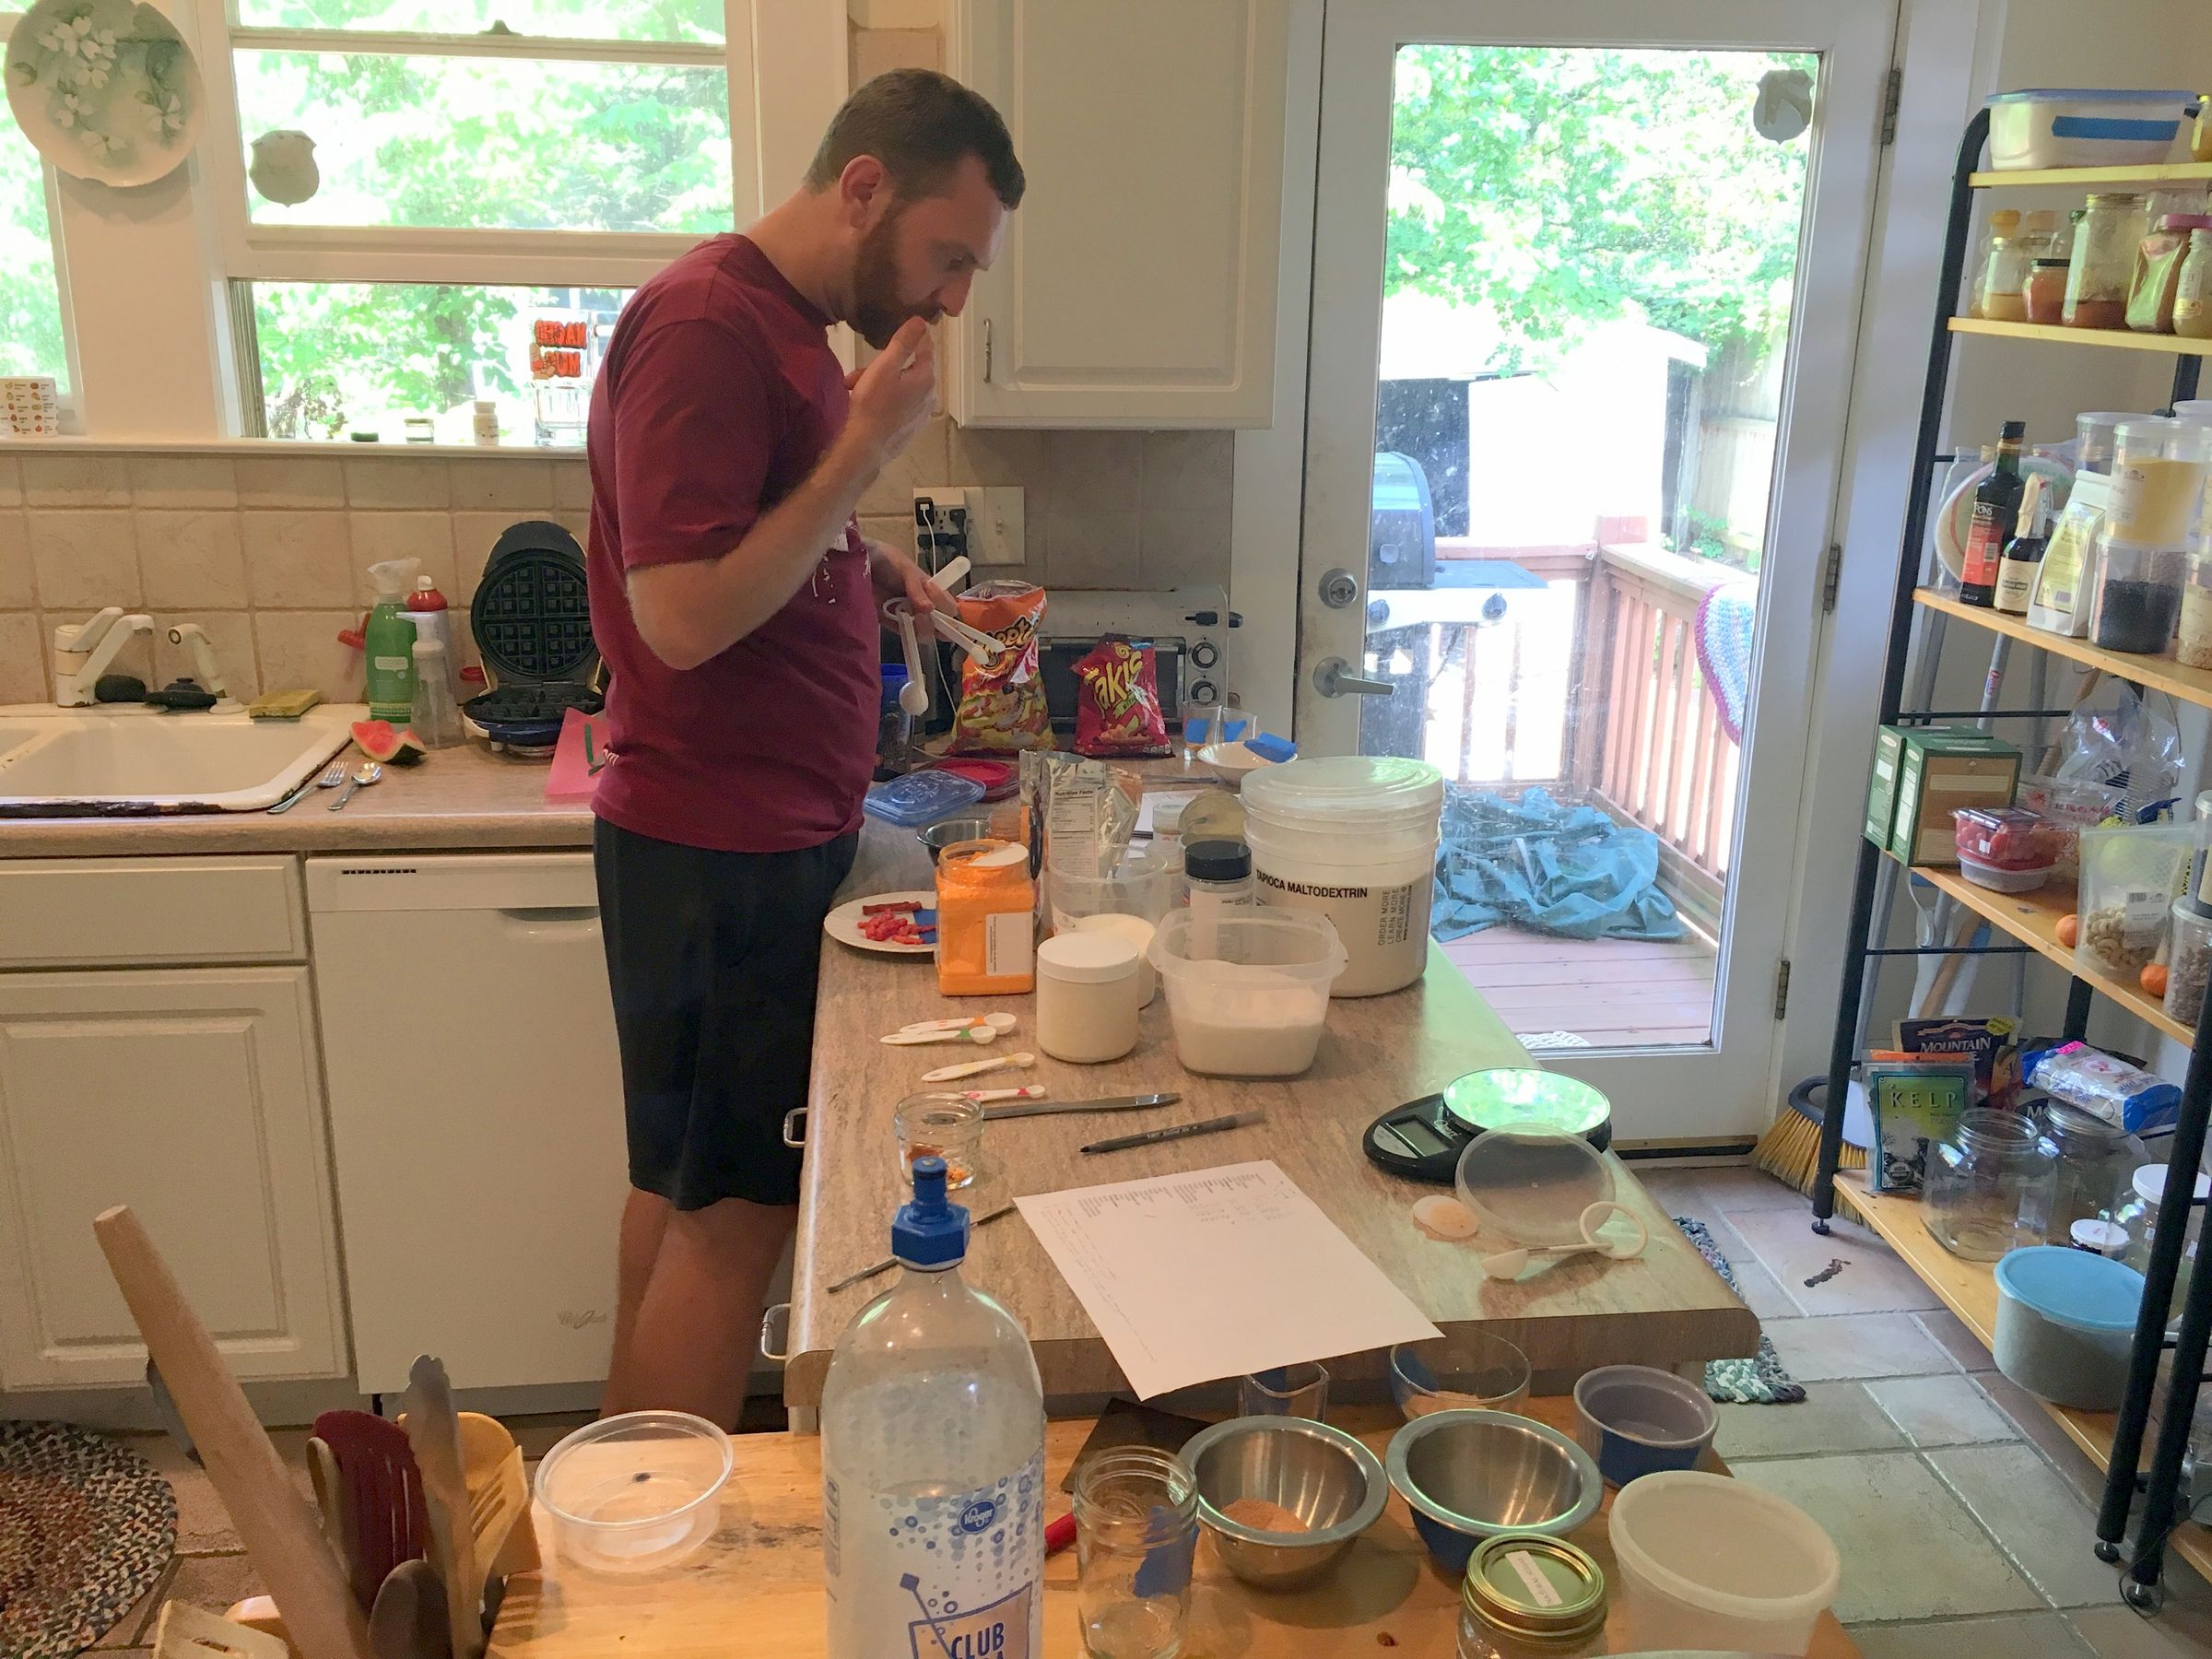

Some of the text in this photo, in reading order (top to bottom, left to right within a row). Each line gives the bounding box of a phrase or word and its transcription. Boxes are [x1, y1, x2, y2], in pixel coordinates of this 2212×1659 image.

[1256, 869, 1368, 899] TAPIOCA MALTODEXTRIN
[1378, 890, 1390, 946] ORDER MORE
[1387, 888, 1399, 945] LEARN MORE
[1395, 915, 1404, 943] CREATE
[1920, 1037, 1992, 1053] MOUNTAIN
[1889, 1091, 1958, 1109] KELP
[963, 1506, 994, 1527] Kroger
[951, 1622, 1005, 1659] CLUB
